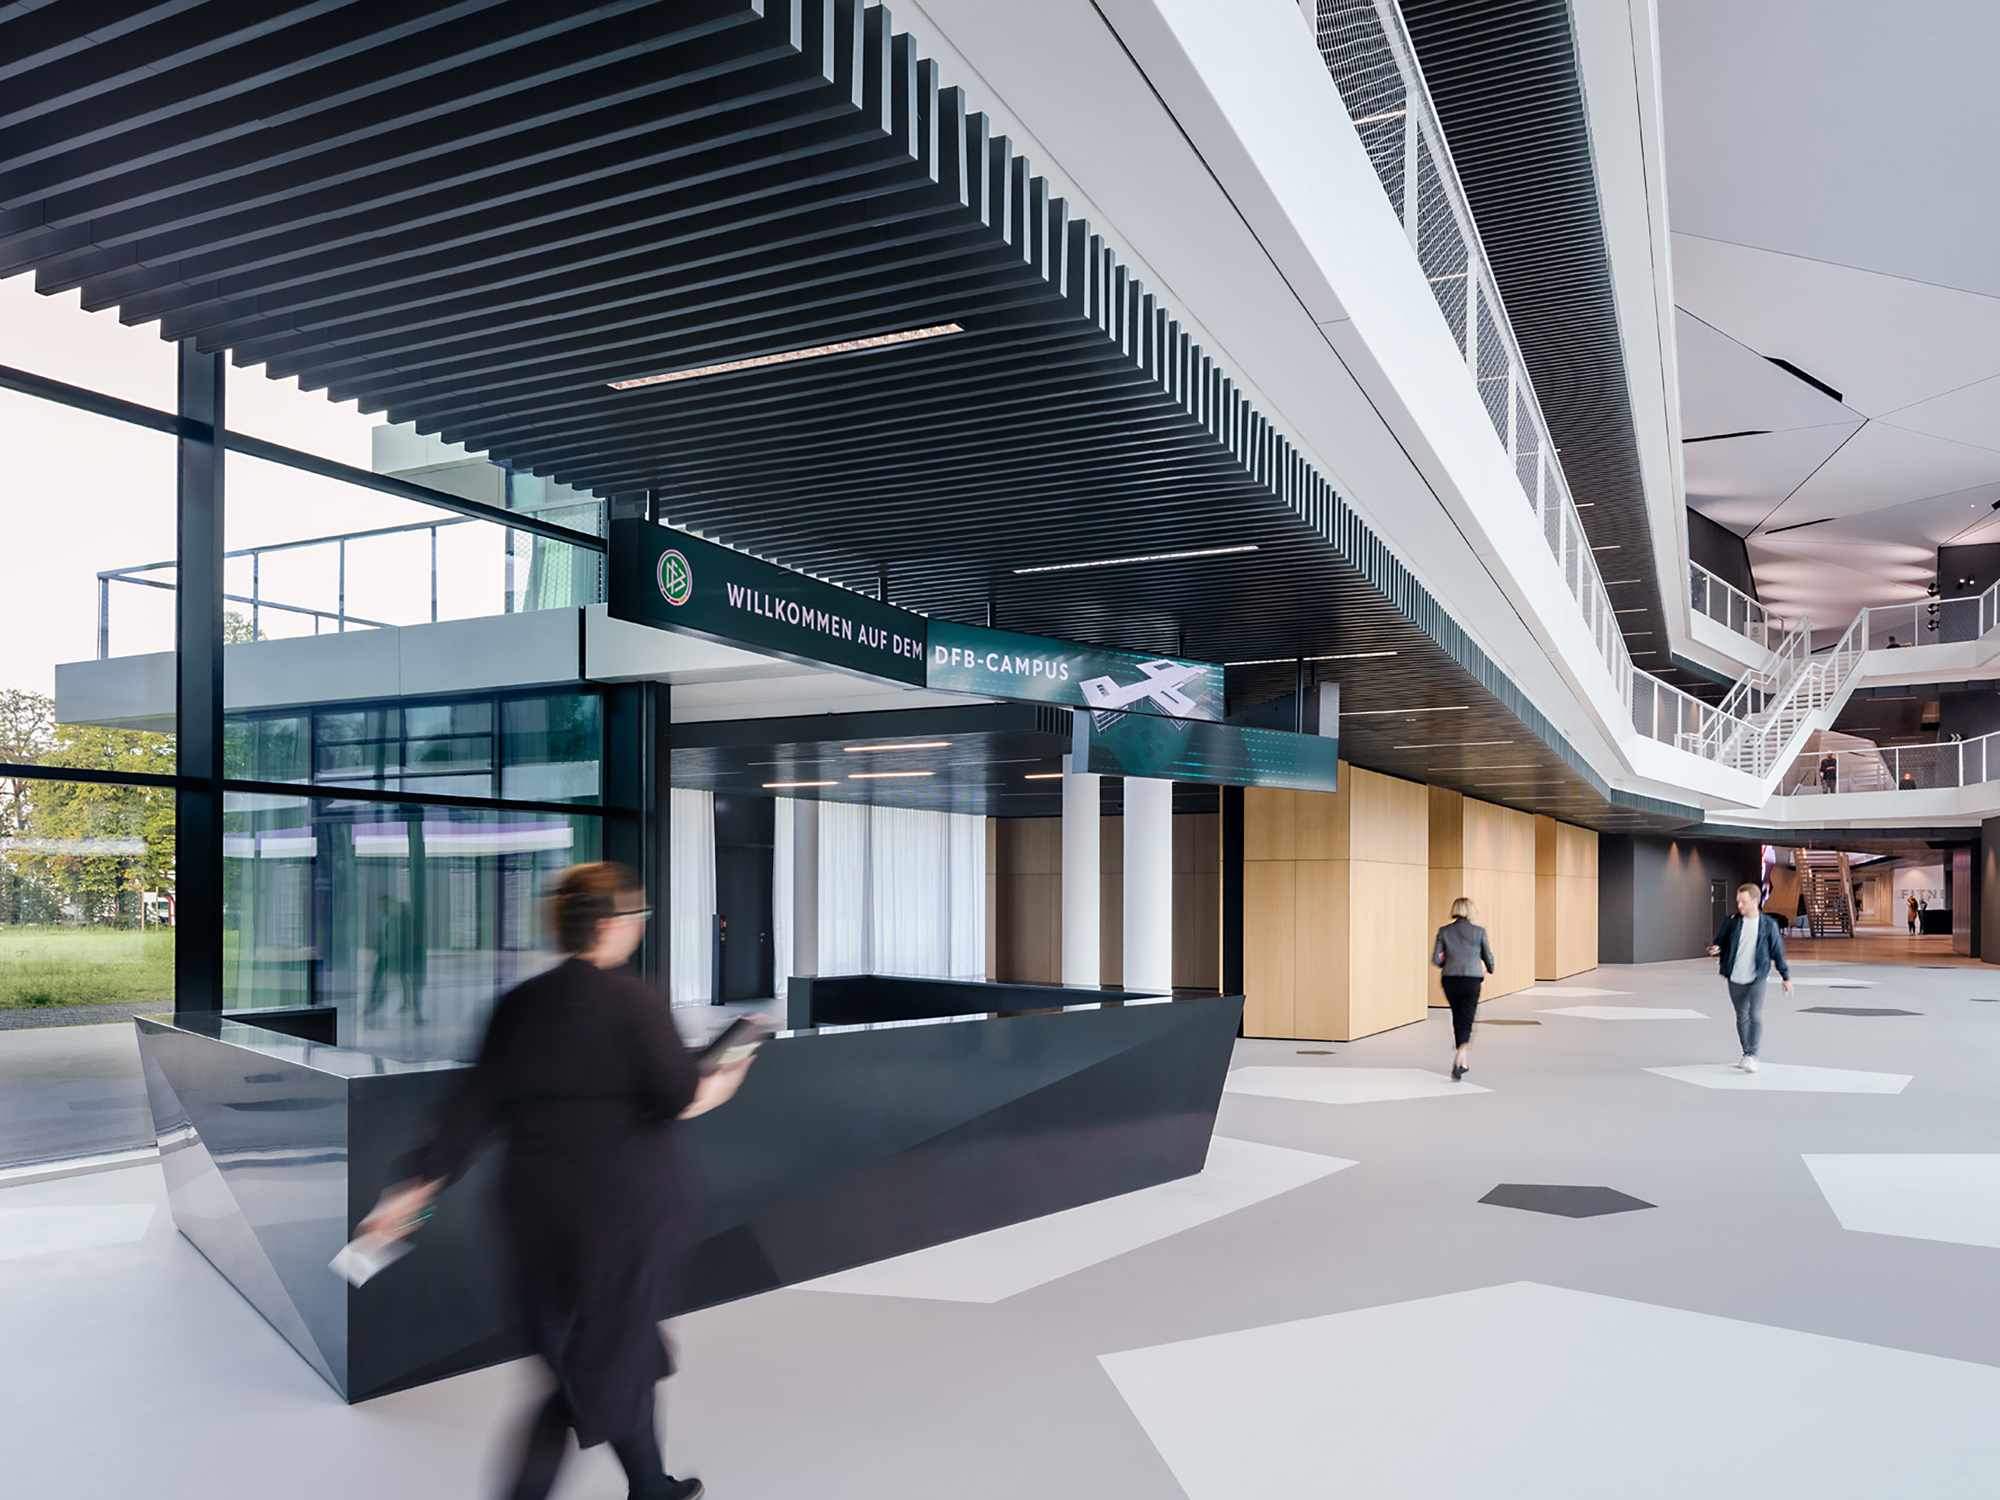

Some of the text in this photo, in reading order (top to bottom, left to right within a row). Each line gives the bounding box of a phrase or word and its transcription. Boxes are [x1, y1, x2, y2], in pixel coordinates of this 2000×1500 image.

[726, 581, 1070, 681] WILLKOMMEN AUF DEM DFB-CAMPUS
